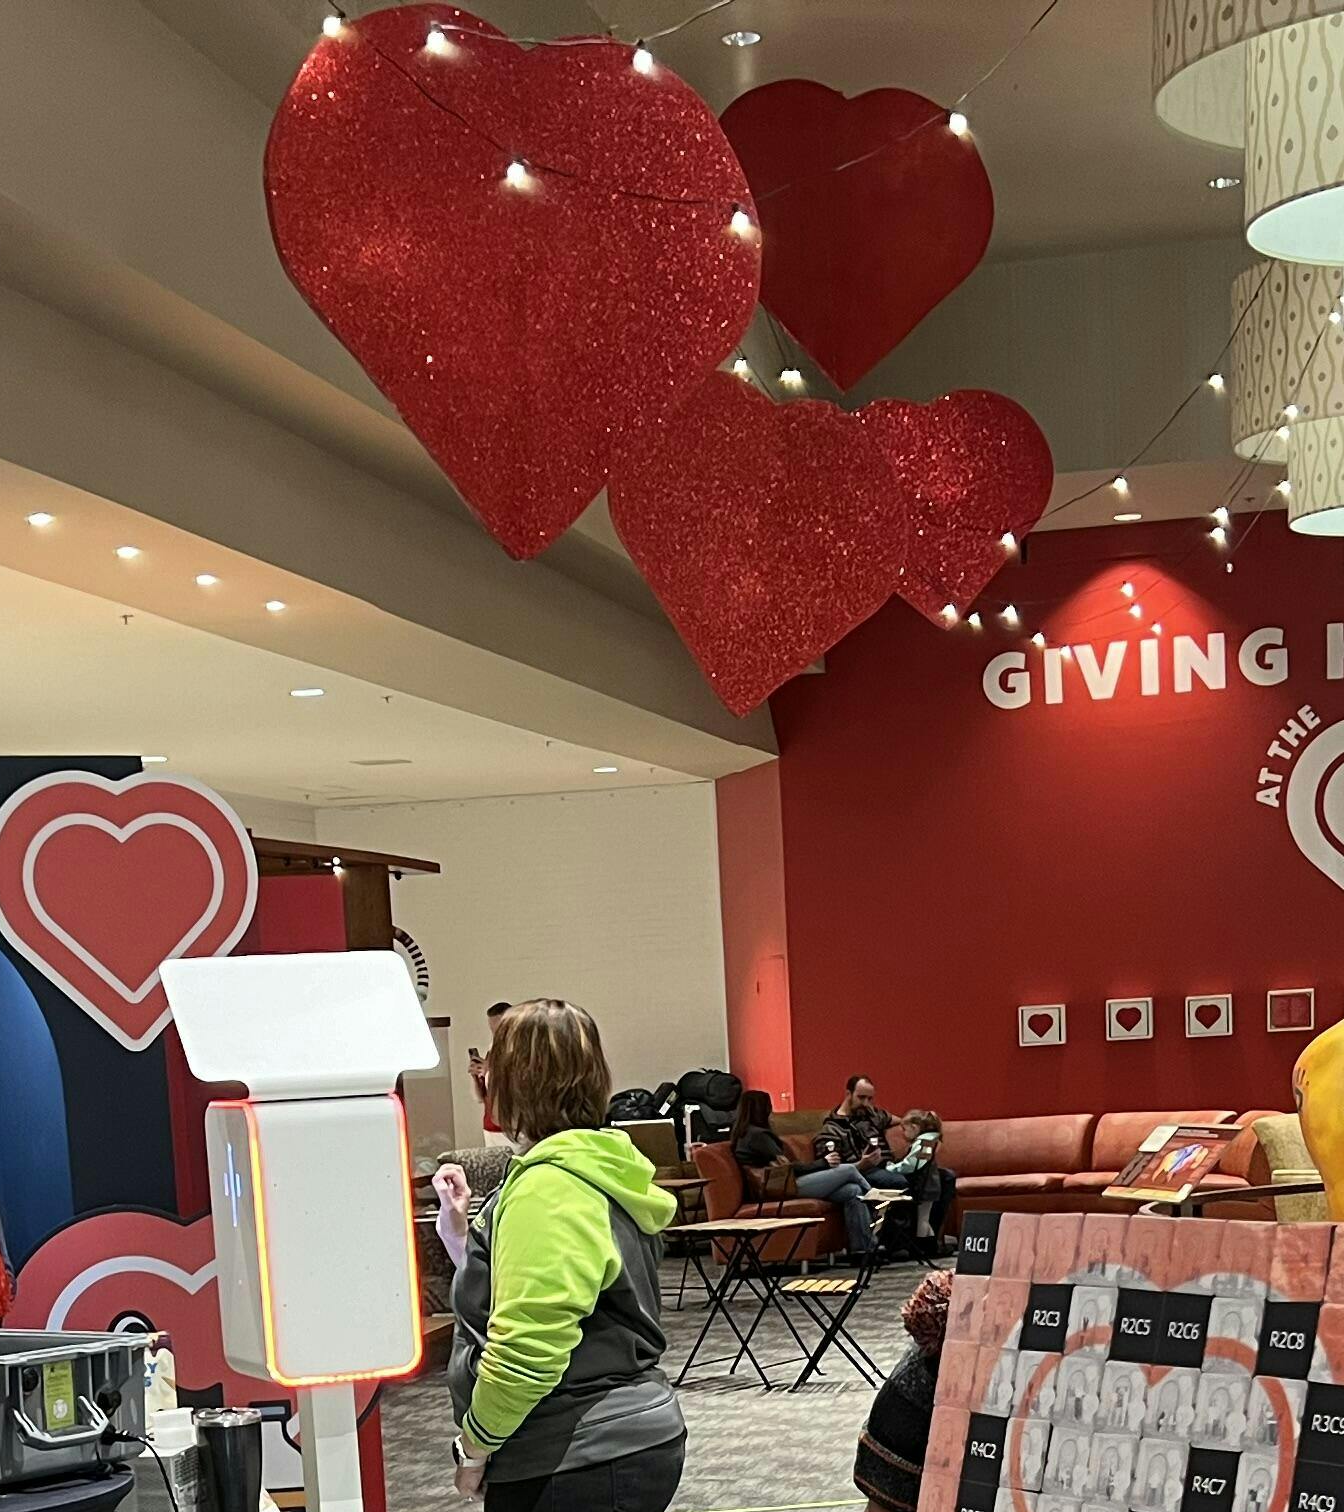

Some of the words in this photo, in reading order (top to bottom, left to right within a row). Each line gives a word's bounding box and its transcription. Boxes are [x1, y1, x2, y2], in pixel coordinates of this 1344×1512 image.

[982, 627, 1289, 710] GIVING
[1266, 704, 1322, 761] THE
[1256, 767, 1284, 809] AT
[964, 1236, 990, 1253] R1C1
[1032, 1309, 1061, 1327] R2C3
[1119, 1317, 1152, 1336] R2C5
[1167, 1321, 1201, 1340] R2C6
[1269, 1330, 1305, 1350] R2C8
[970, 1440, 997, 1460] R4C2
[1191, 1475, 1227, 1496] R4C7
